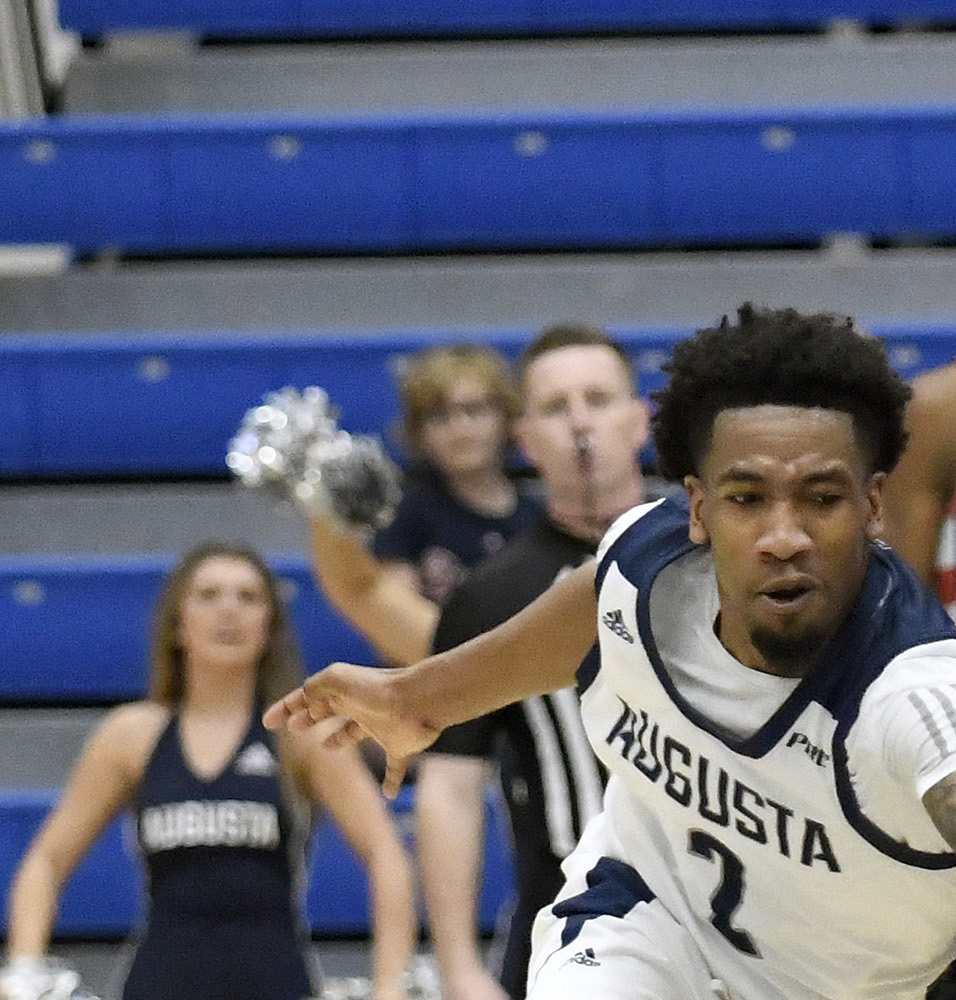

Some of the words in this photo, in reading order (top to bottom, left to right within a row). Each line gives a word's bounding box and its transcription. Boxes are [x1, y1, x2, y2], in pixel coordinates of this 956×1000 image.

[139, 801, 280, 852] AUGUSTA
[606, 694, 842, 873] AUGUSTA
[687, 828, 763, 959] 2
